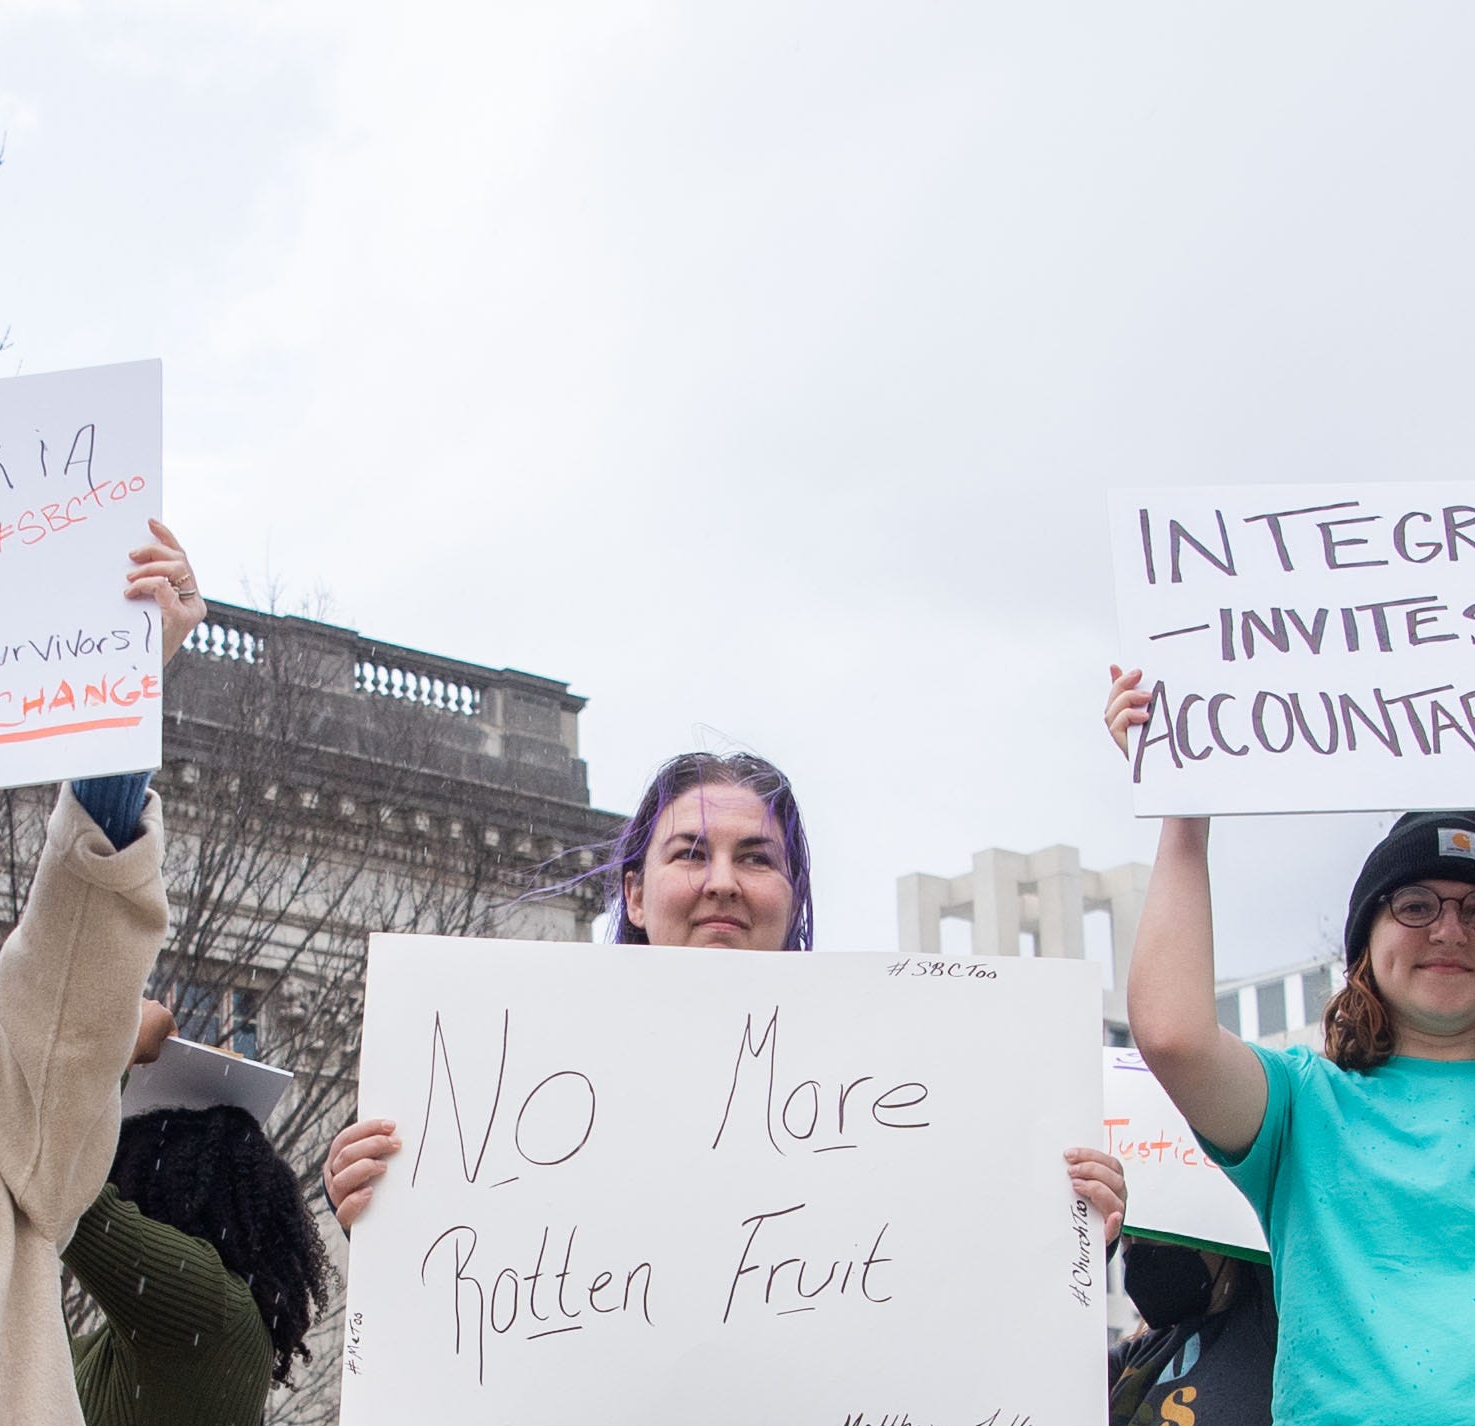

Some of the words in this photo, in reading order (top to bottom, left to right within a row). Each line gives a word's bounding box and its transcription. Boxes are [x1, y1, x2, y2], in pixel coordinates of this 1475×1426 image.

[411, 1008, 596, 1188] No
[713, 1006, 930, 1157] More
[422, 1225, 655, 1386] Rotten
[724, 1203, 893, 1324] Fruit
